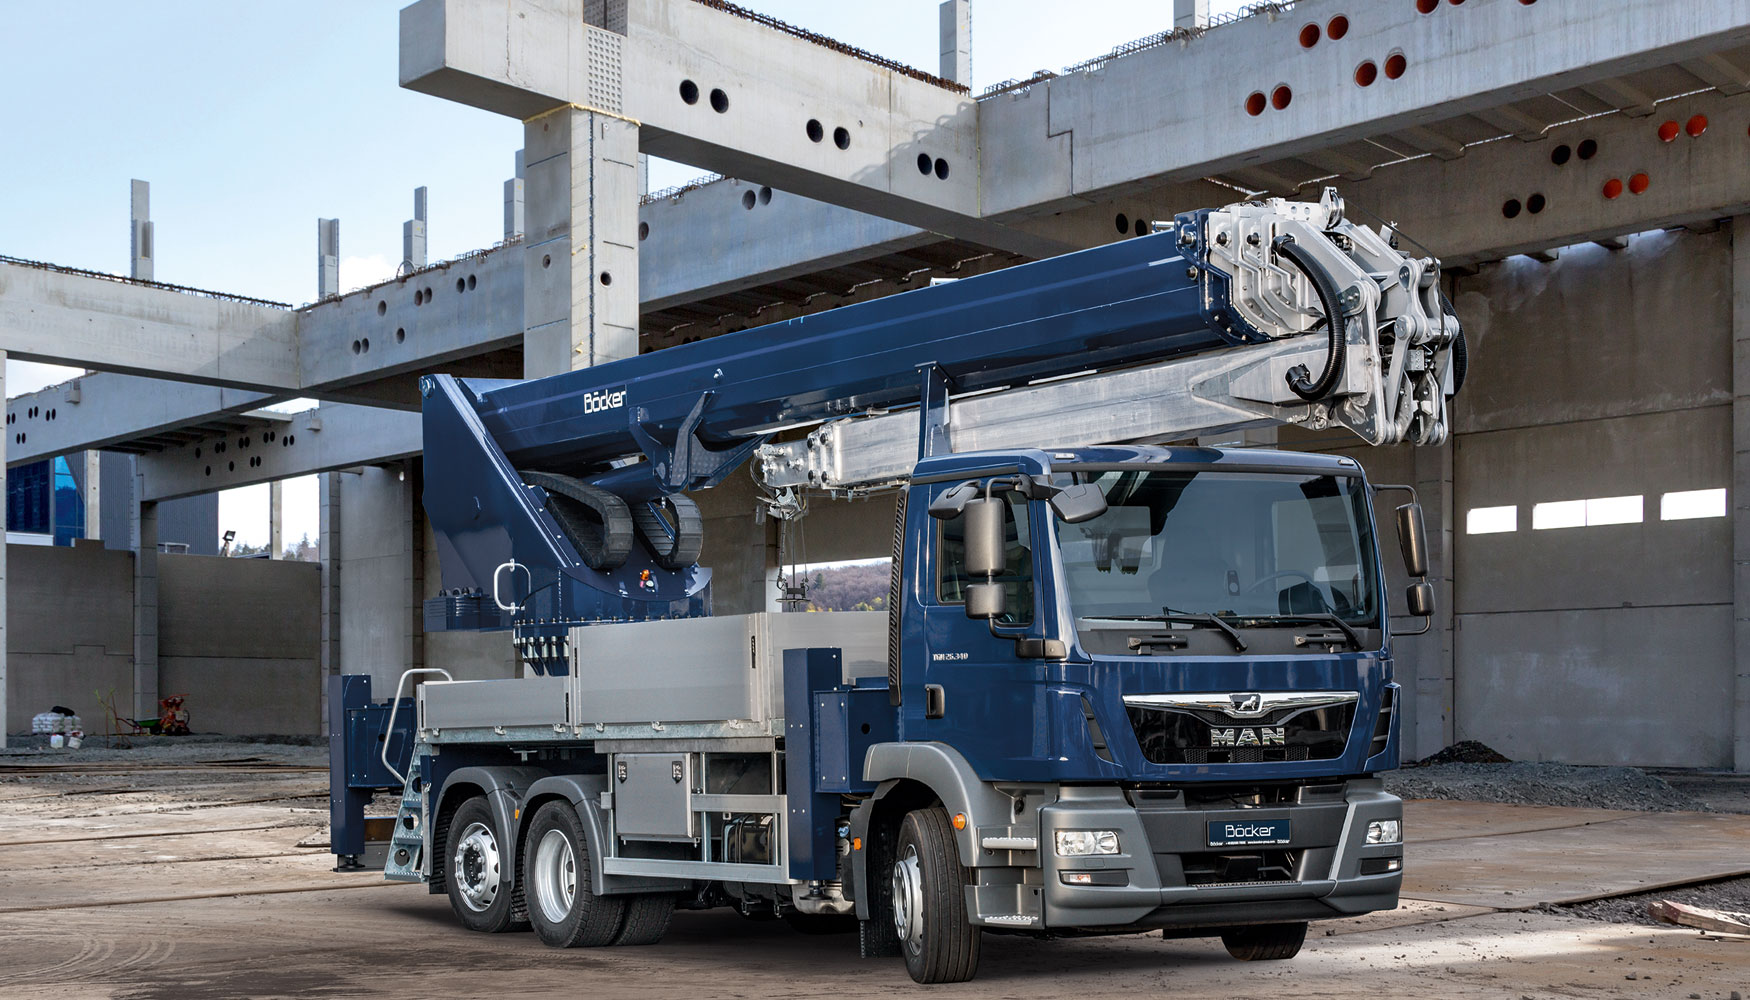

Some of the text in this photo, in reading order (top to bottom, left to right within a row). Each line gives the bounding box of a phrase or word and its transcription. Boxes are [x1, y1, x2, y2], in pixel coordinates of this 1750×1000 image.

[583, 388, 627, 415] Böcker
[1210, 727, 1285, 747] MAN
[1225, 823, 1275, 838] Böcker
